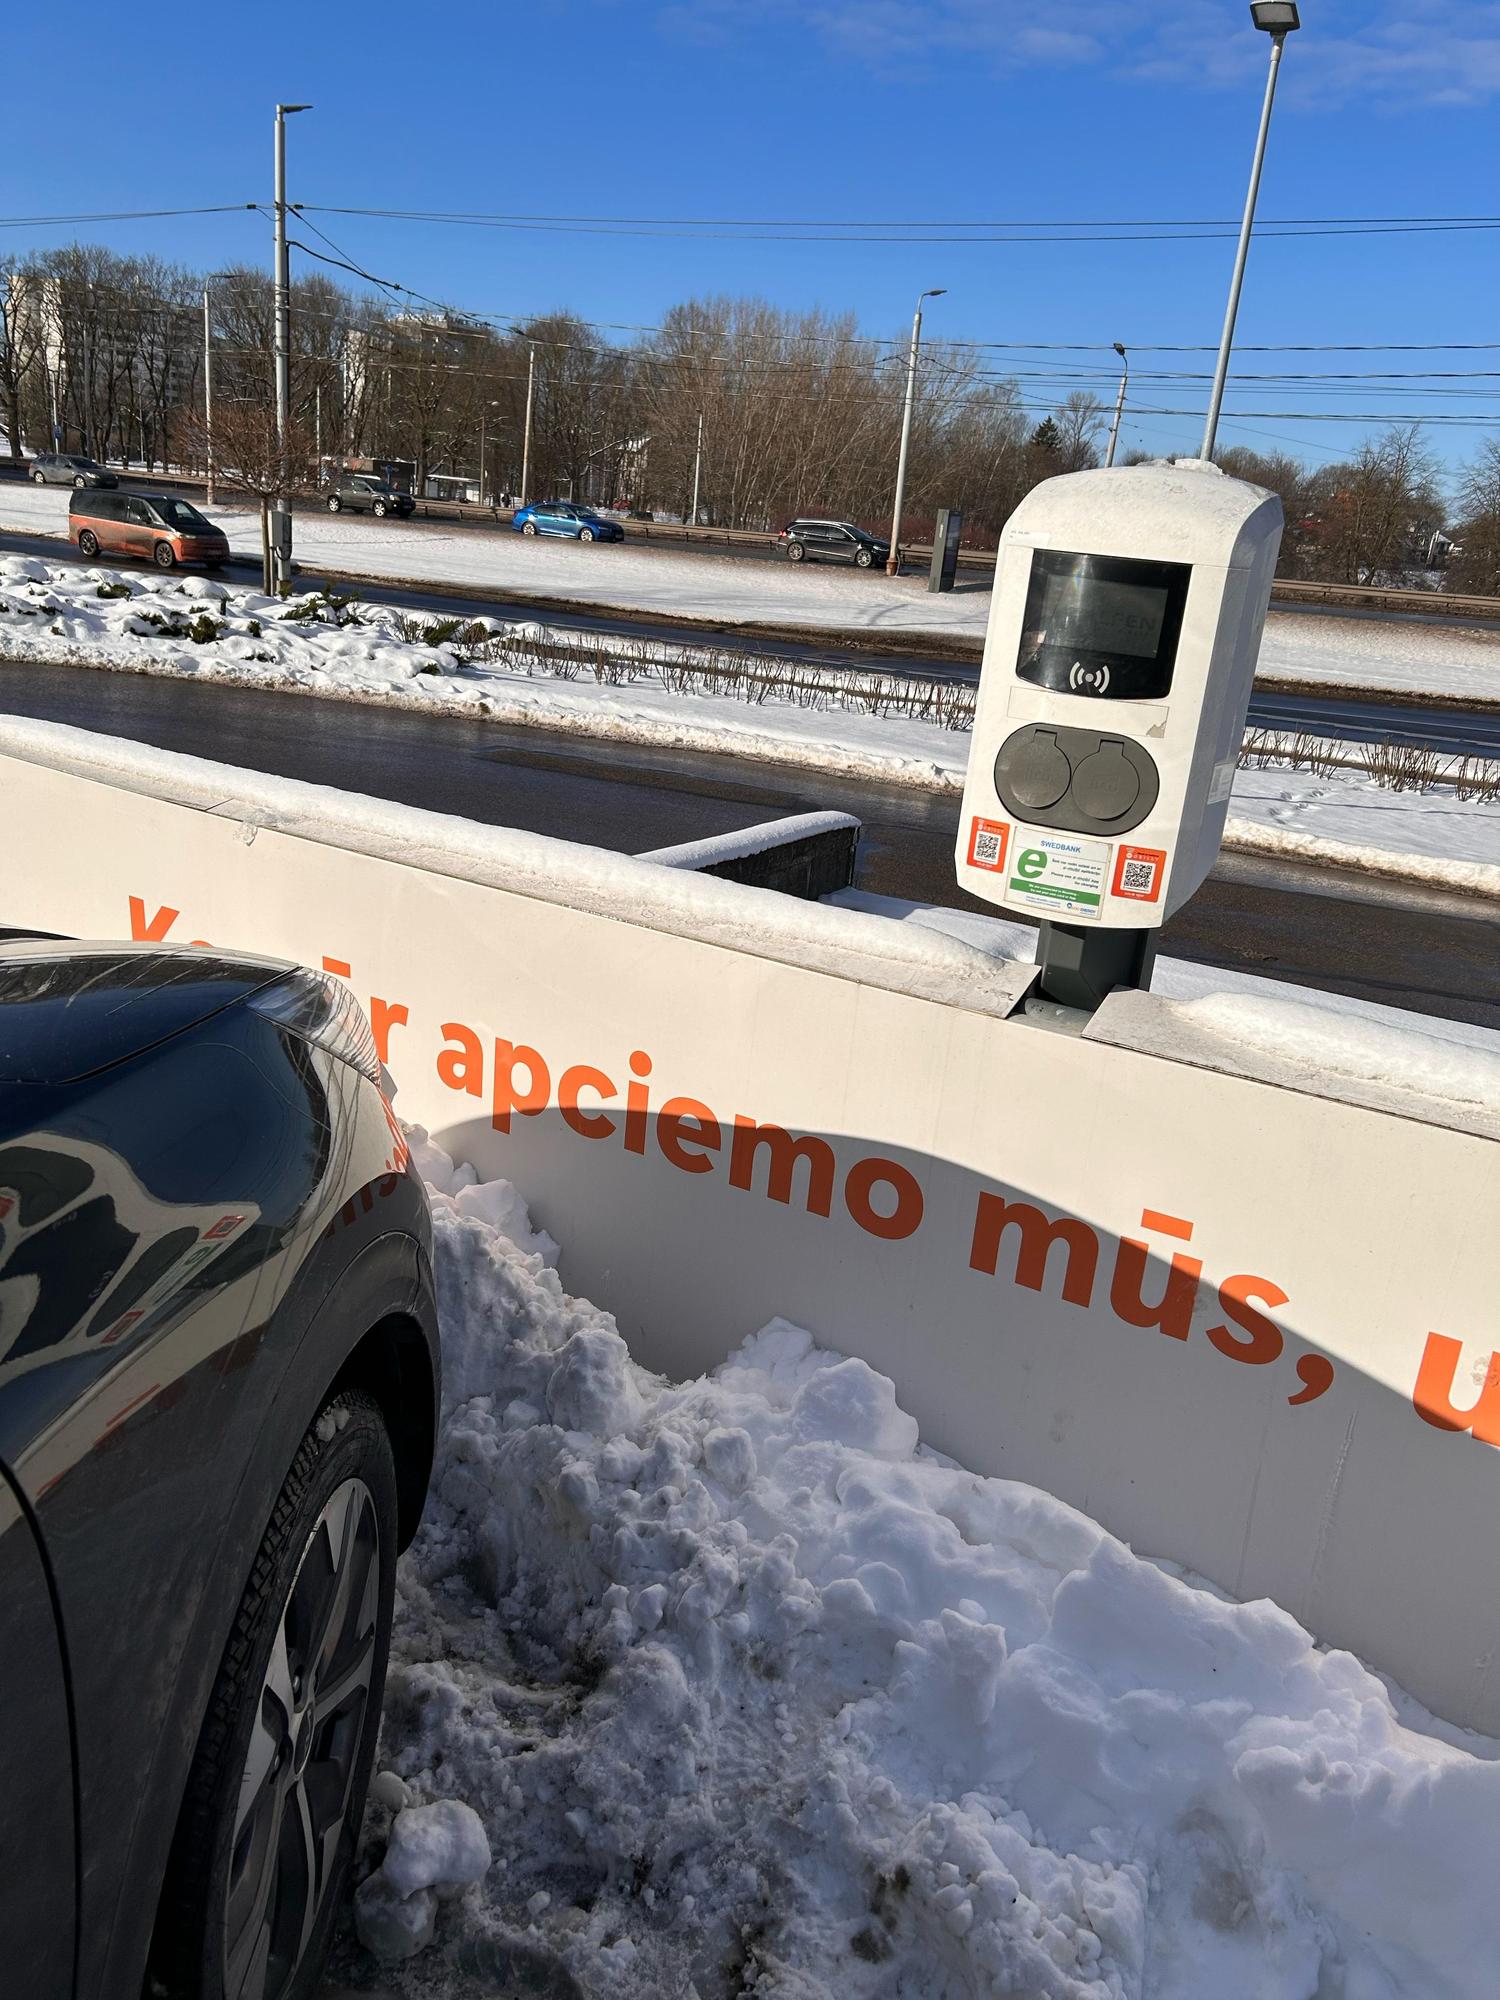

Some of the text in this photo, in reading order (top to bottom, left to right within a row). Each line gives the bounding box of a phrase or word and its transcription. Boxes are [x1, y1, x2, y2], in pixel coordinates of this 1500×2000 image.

[1040, 840, 1081, 853] SWEDBANK
[436, 1022, 925, 1240] apciemo
[969, 1191, 1335, 1406] mūs,
